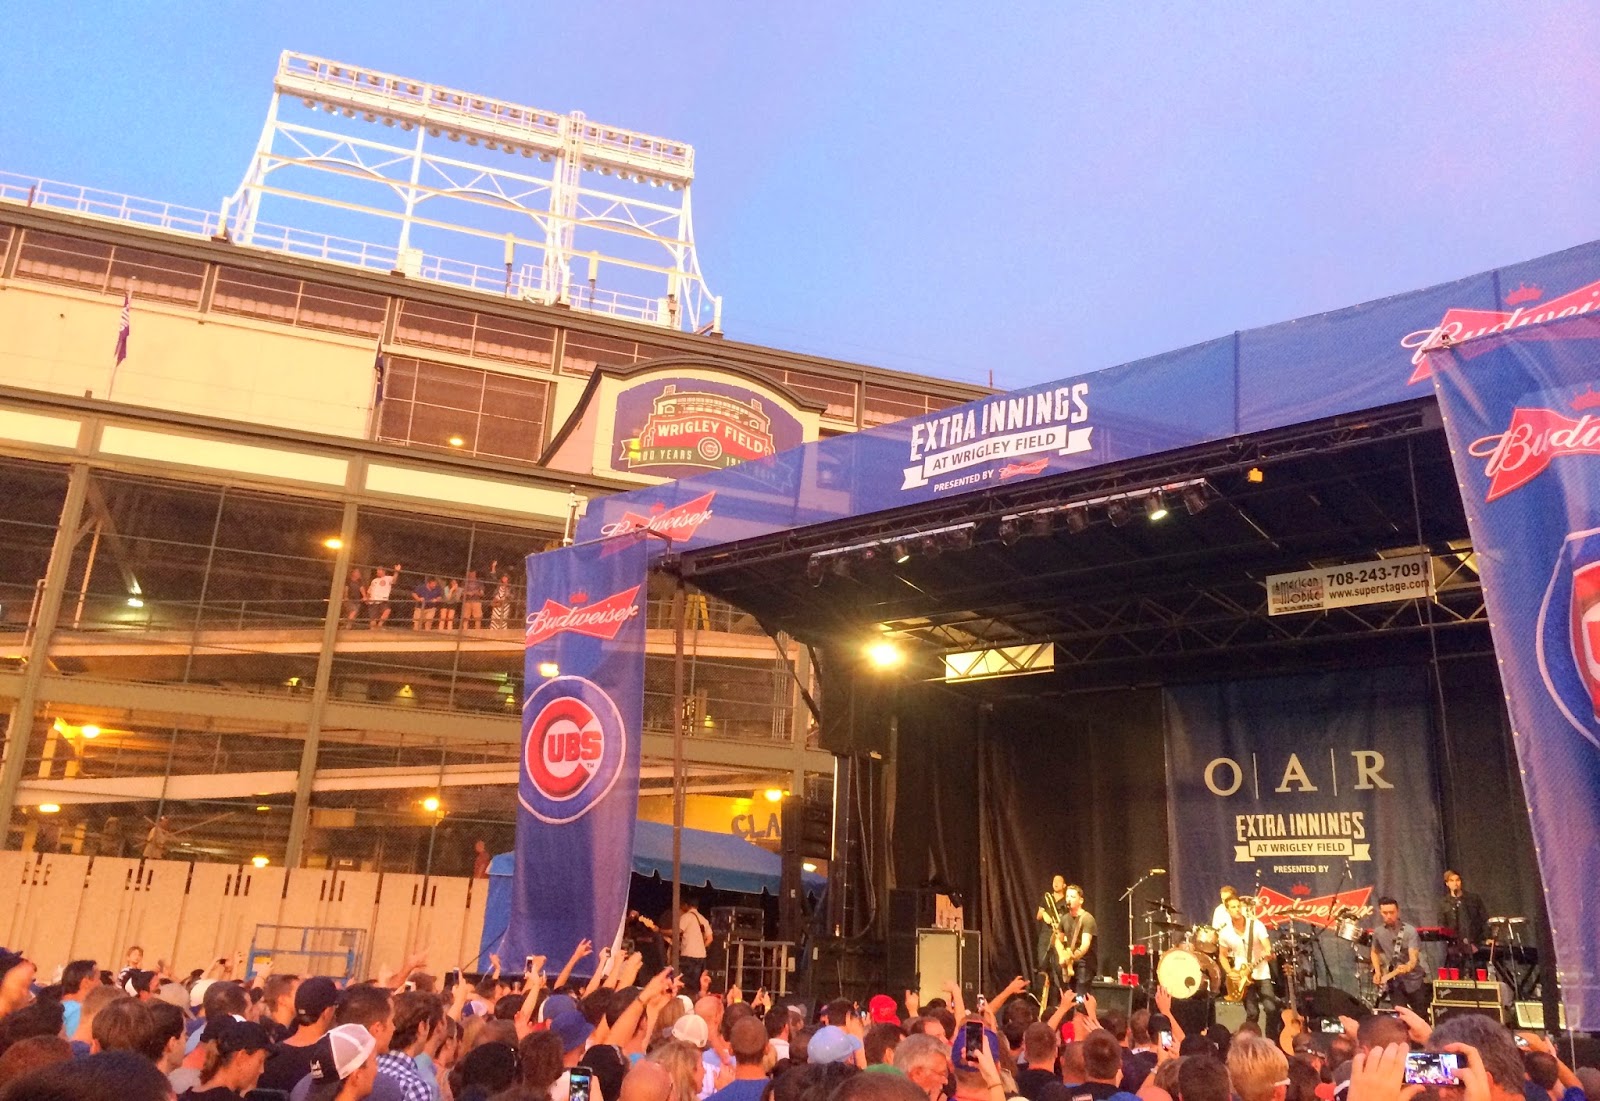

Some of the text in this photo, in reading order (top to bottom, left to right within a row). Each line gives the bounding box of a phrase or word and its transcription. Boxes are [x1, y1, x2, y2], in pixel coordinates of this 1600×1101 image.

[910, 382, 1089, 461] EXTRA INNINGS
[657, 420, 720, 437] WRIGLEY
[724, 427, 764, 454] FIELD
[660, 449, 692, 461] YEARS
[932, 433, 1056, 471] AT WRIGLEY FIELD
[933, 473, 980, 492] PRESENTED
[982, 469, 994, 480] BY
[601, 508, 713, 537] Bdweiser
[1326, 560, 1429, 587] 708-243-7091
[1329, 578, 1430, 600] www.superstage.com
[526, 603, 639, 637] Budweiser
[526, 697, 604, 800] CUBS
[1235, 811, 1366, 841] EXTRA INNINGS
[1256, 842, 1346, 853] AT WRIGLEY FIELD
[1273, 865, 1329, 873] PRESENTED BY
